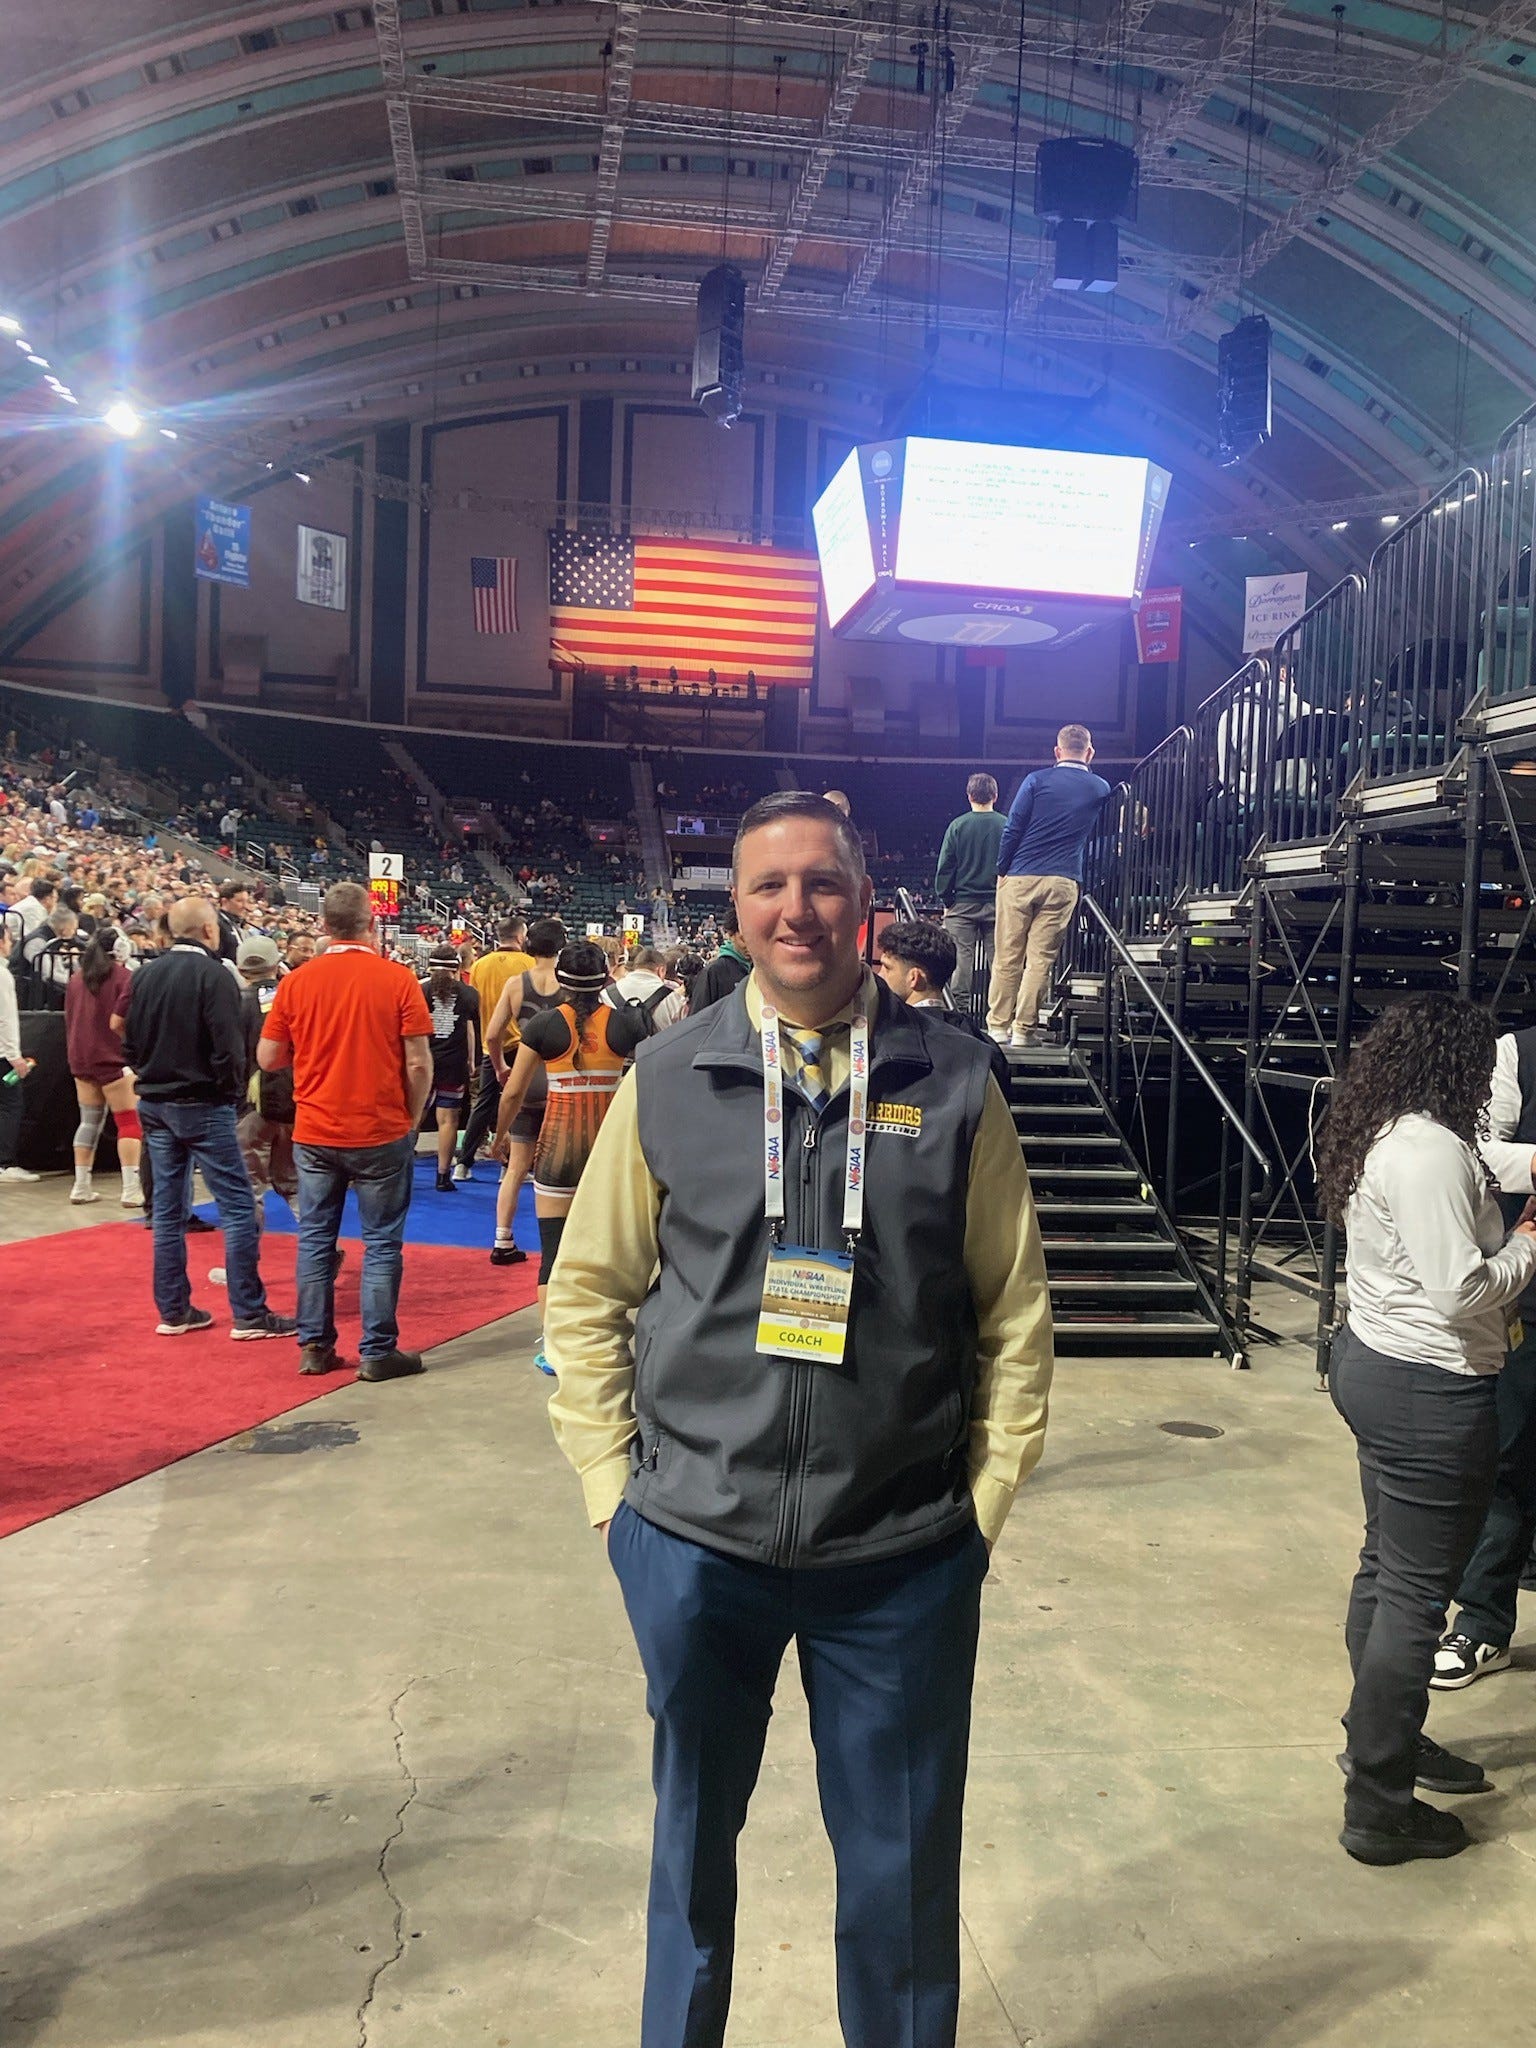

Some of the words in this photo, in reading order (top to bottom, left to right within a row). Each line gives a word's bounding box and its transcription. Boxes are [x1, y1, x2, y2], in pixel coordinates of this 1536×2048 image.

[973, 602, 1020, 613] CRDA
[1251, 614, 1266, 622] ICE
[1272, 611, 1298, 621] RINK
[382, 857, 392, 876] 2
[632, 917, 638, 930] 3
[867, 1101, 922, 1127] ARRIORS
[866, 1122, 918, 1136] RESTLING
[768, 1278, 807, 1290] INDIVIDUAL
[809, 1284, 847, 1295] WRESTLING
[768, 1285, 789, 1294] STATE
[789, 1288, 845, 1302] CHAMPIONSHIPS
[779, 1331, 822, 1346] COACH
